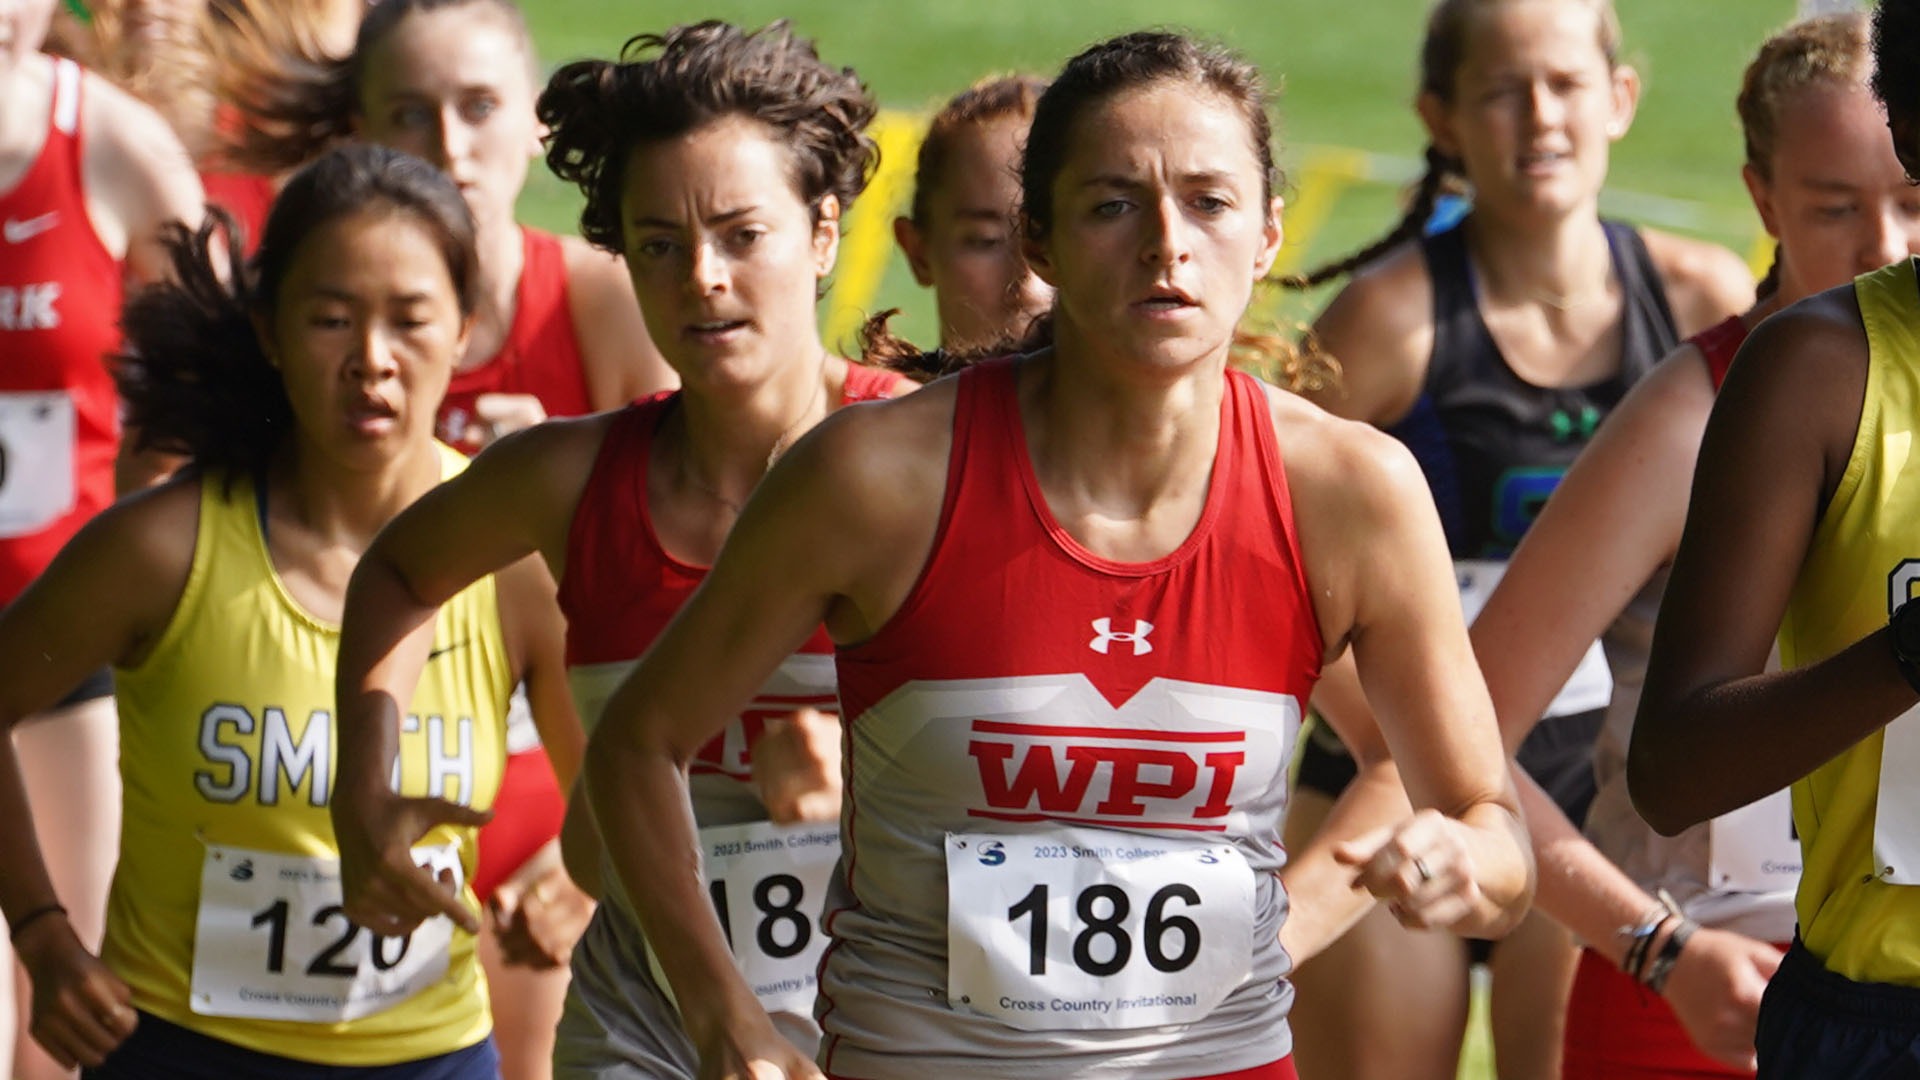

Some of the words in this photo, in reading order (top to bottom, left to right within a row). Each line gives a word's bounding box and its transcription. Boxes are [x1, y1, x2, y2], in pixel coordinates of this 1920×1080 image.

[968, 739, 1245, 818] WPI
[1034, 846, 1067, 858] 2023
[1072, 845, 1112, 858] Smith
[1008, 883, 1201, 977] 186
[1000, 997, 1045, 1012] Cross
[1051, 998, 1111, 1014] Country
[1117, 993, 1197, 1010] Invitational
